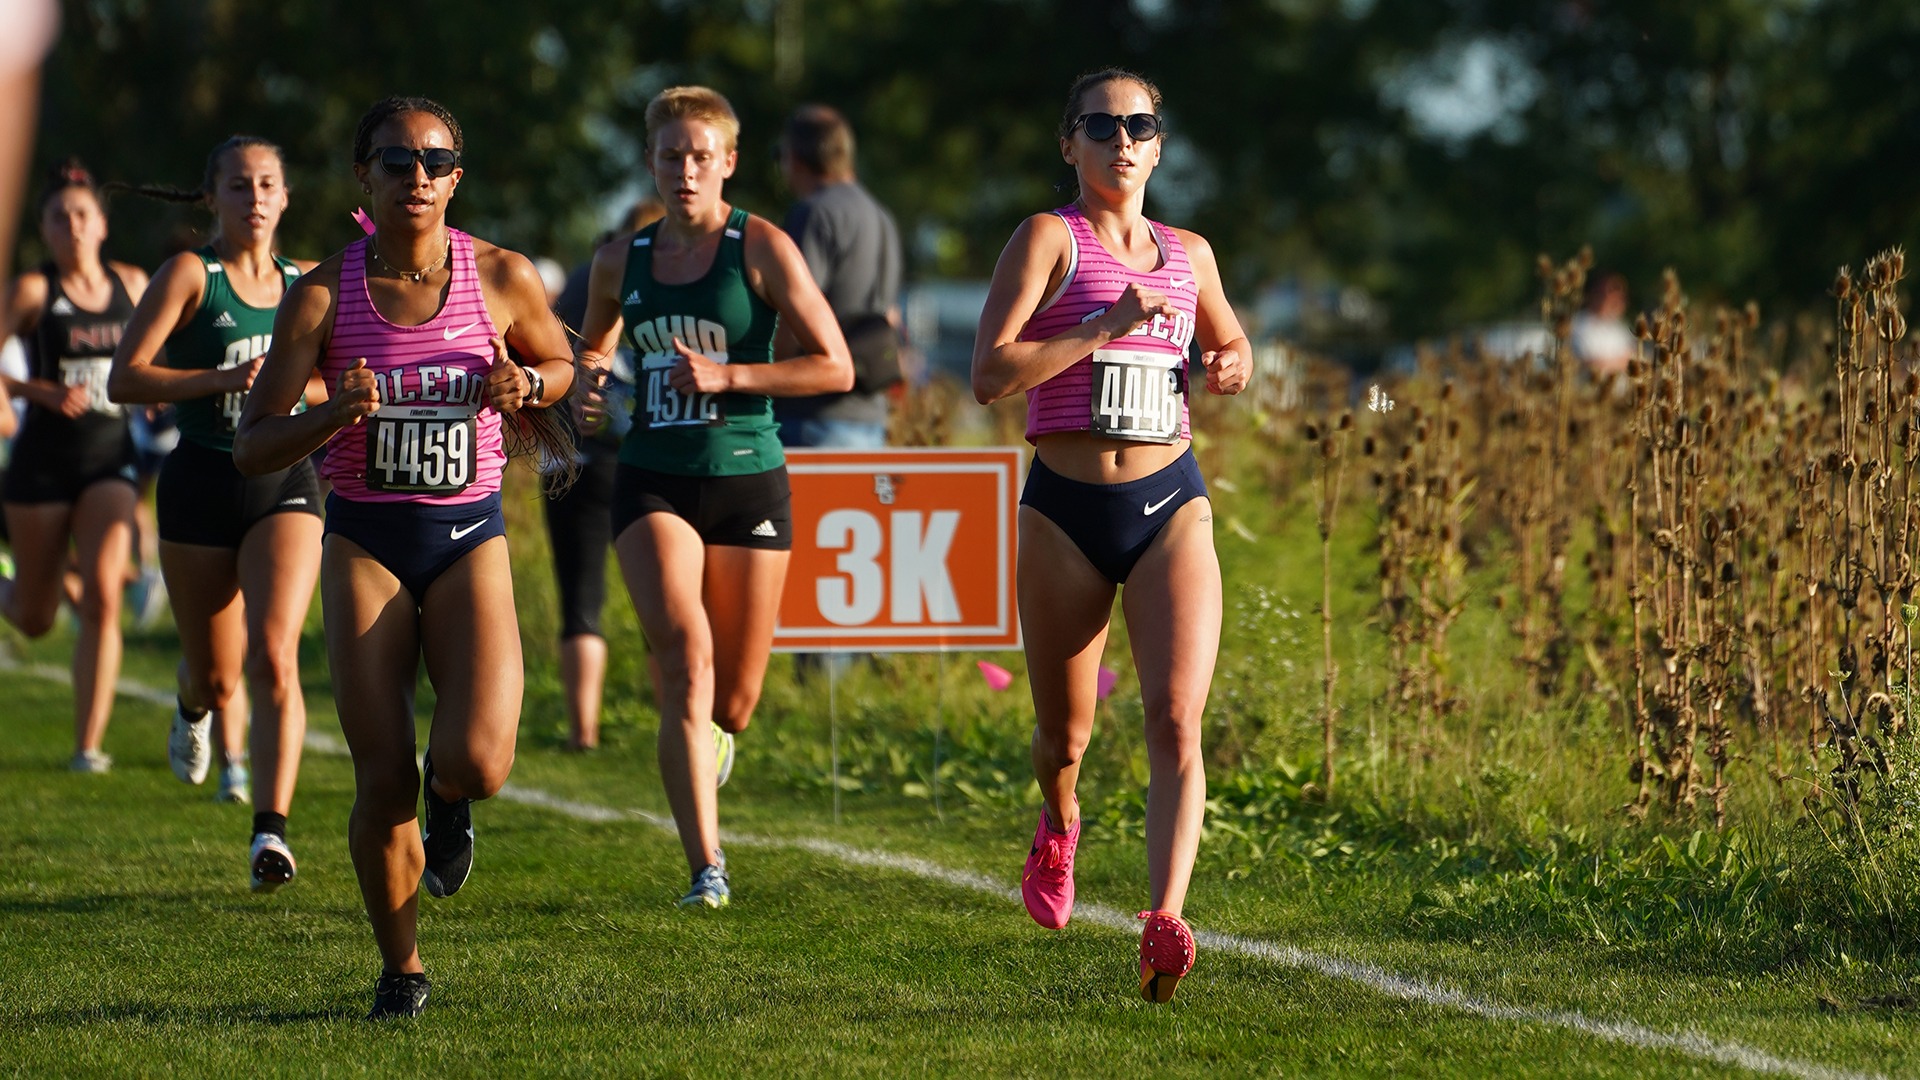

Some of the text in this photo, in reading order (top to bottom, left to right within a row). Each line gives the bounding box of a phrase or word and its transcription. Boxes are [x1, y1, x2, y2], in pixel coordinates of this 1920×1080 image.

[217, 334, 272, 371] OH
[633, 315, 728, 358] OHIO
[375, 366, 485, 409] OLEDO
[1100, 365, 1178, 434] 4446
[375, 421, 468, 486] 4459
[815, 508, 962, 625] 3K
